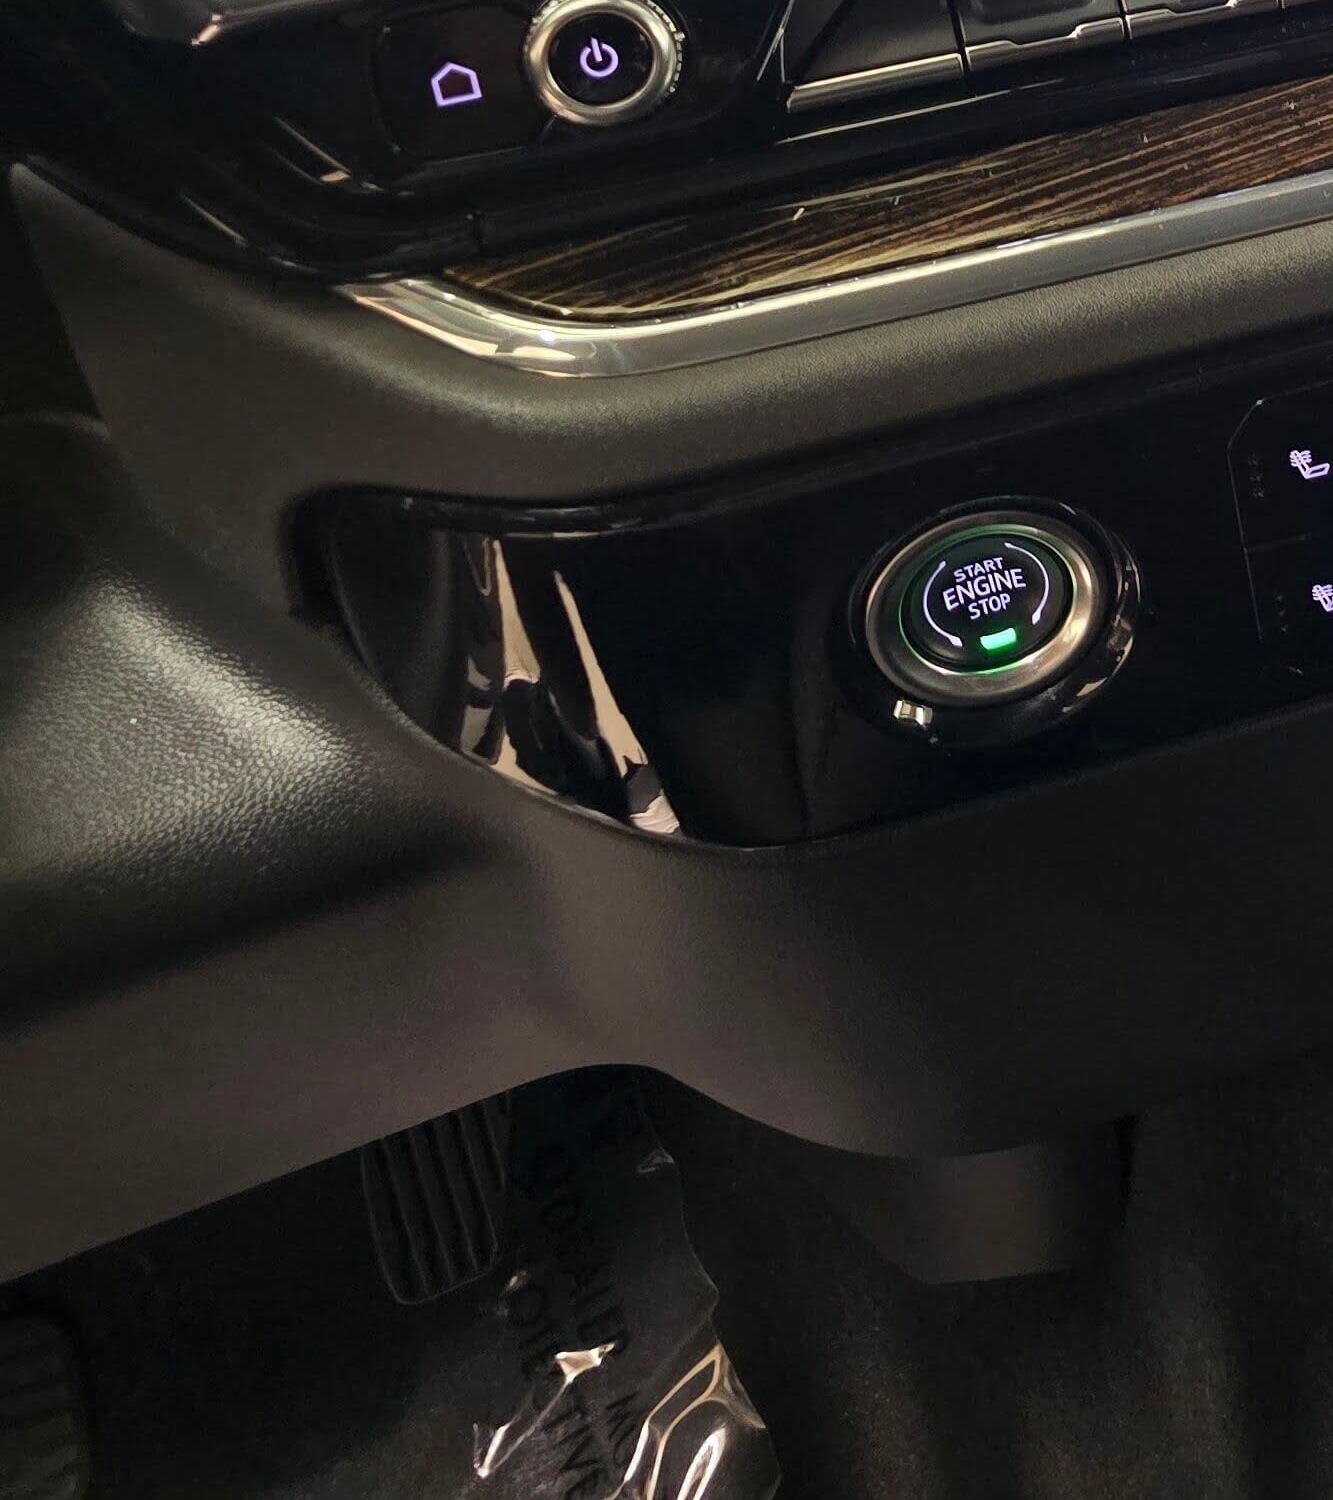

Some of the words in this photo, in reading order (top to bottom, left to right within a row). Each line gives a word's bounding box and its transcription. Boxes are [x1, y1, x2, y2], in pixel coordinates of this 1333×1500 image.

[954, 556, 1004, 583] START
[942, 568, 1026, 611] ENGINE
[967, 593, 1011, 620] STOP
